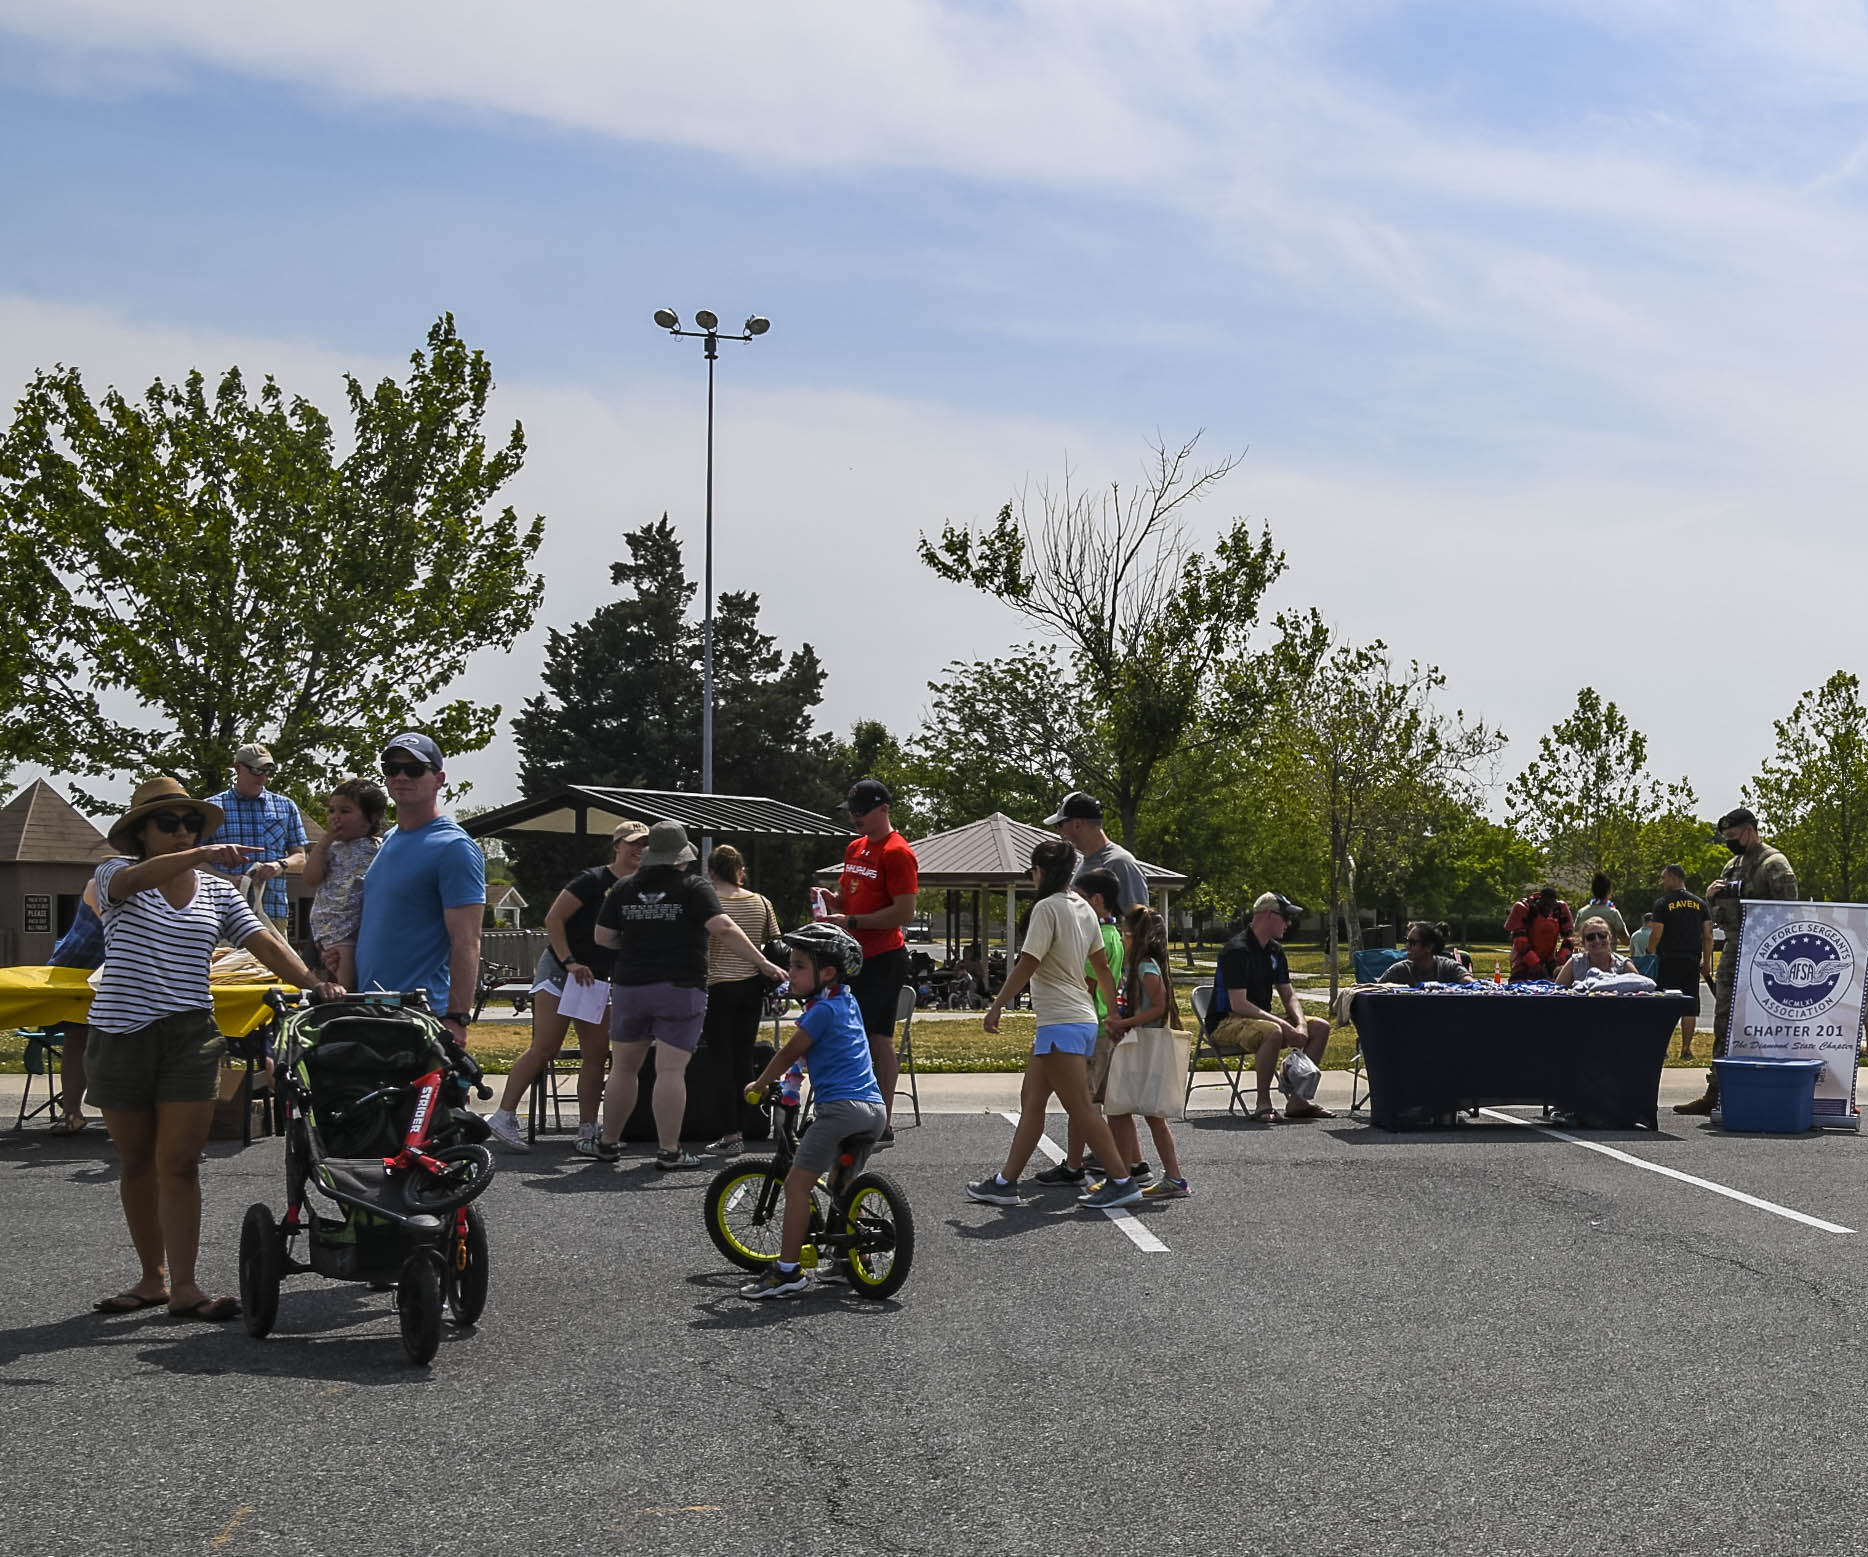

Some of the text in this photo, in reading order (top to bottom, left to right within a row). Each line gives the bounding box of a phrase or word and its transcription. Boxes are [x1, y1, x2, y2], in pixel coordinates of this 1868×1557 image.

[1668, 900, 1700, 911] RAVEN
[1759, 923, 1851, 960] AIR FORCE SERGEANTS
[1789, 962, 1814, 980] AFSA
[1762, 996, 1834, 1018] ASSOCIATION
[1782, 998, 1814, 1007] MCMLXI
[1743, 1025, 1843, 1037] CHAPTER 201
[1732, 1040, 1854, 1051] The Diamond State Chapter
[409, 1086, 433, 1133] STRIDER
